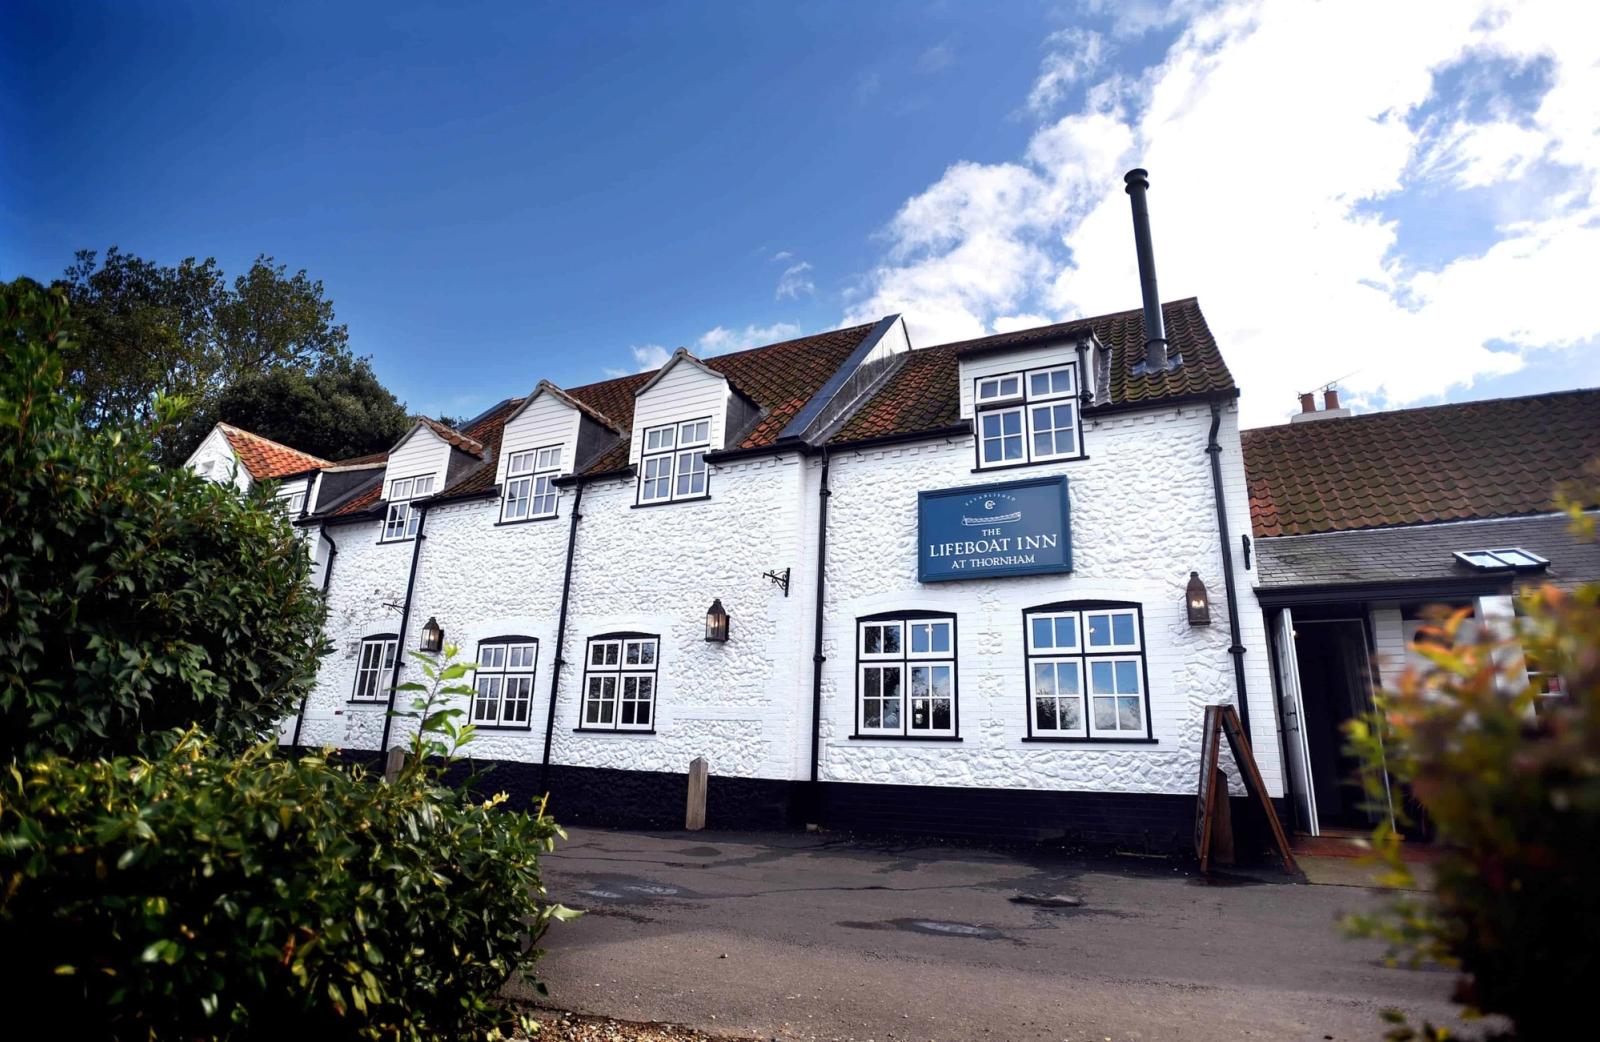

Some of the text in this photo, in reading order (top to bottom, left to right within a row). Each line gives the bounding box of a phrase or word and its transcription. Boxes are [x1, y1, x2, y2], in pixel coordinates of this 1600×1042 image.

[981, 528, 1001, 537] THE
[929, 533, 1058, 558] LIFEBOAT INN
[951, 554, 1035, 569] AT THORNHAM
